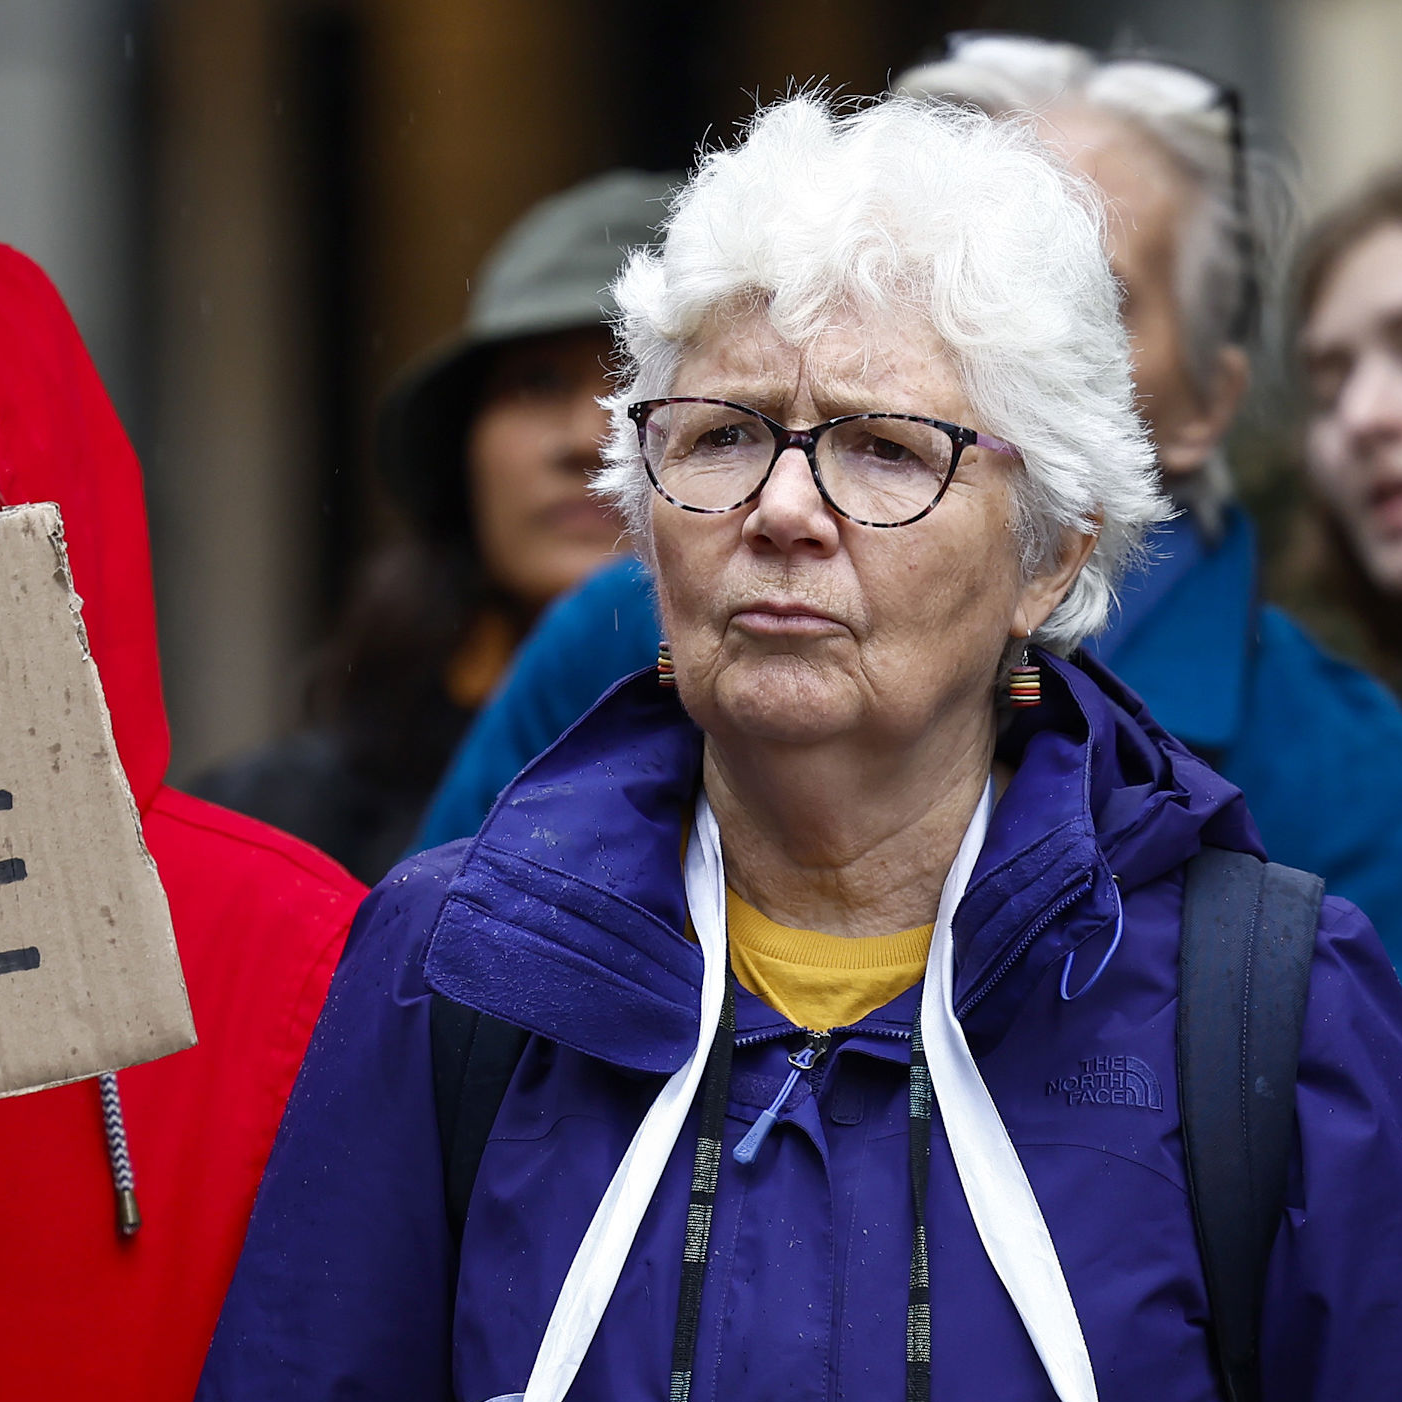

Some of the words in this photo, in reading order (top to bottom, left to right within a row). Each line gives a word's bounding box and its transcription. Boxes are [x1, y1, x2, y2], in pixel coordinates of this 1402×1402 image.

[1079, 1055, 1125, 1073] THE
[1047, 1072, 1124, 1096] NORTH
[1068, 1089, 1125, 1106] FACE
